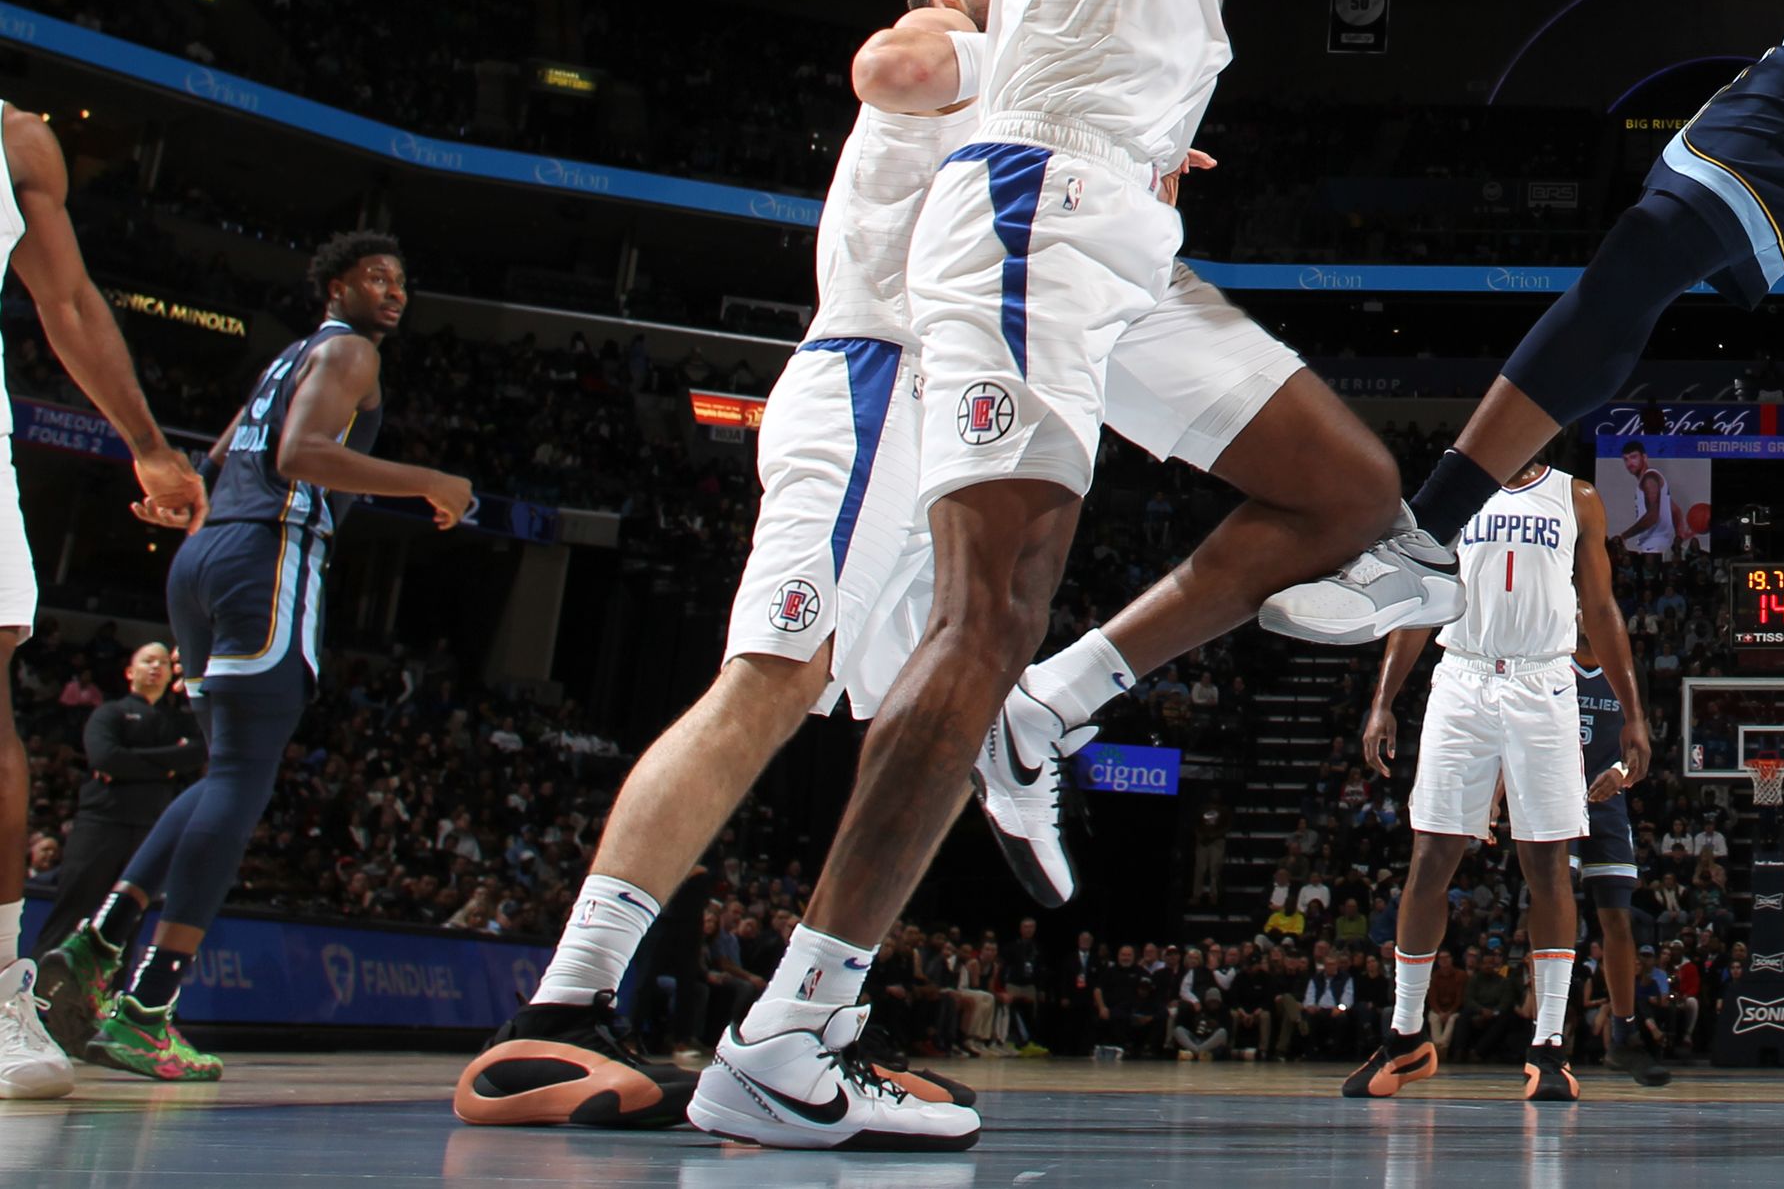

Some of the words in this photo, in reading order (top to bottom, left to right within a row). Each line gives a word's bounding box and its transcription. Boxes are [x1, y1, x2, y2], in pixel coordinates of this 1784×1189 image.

[185, 66, 259, 110] Orion
[1624, 118, 1648, 130] BIG
[391, 130, 463, 170] Orion
[534, 157, 609, 193] Orion
[1531, 184, 1576, 201] BRS
[1298, 266, 1362, 291] Orion
[1486, 266, 1551, 291] Orion
[167, 304, 248, 339] MINOLTA
[27, 425, 89, 451] FOULS:
[92, 437, 104, 454] 2
[1697, 440, 1761, 454] MEMPHIS
[1505, 550, 1514, 592] 1
[1747, 570, 1784, 591] 19.7
[1088, 758, 1167, 791] cigna
[1755, 958, 1781, 967] SONIC
[361, 960, 463, 1000] FANDUEL
